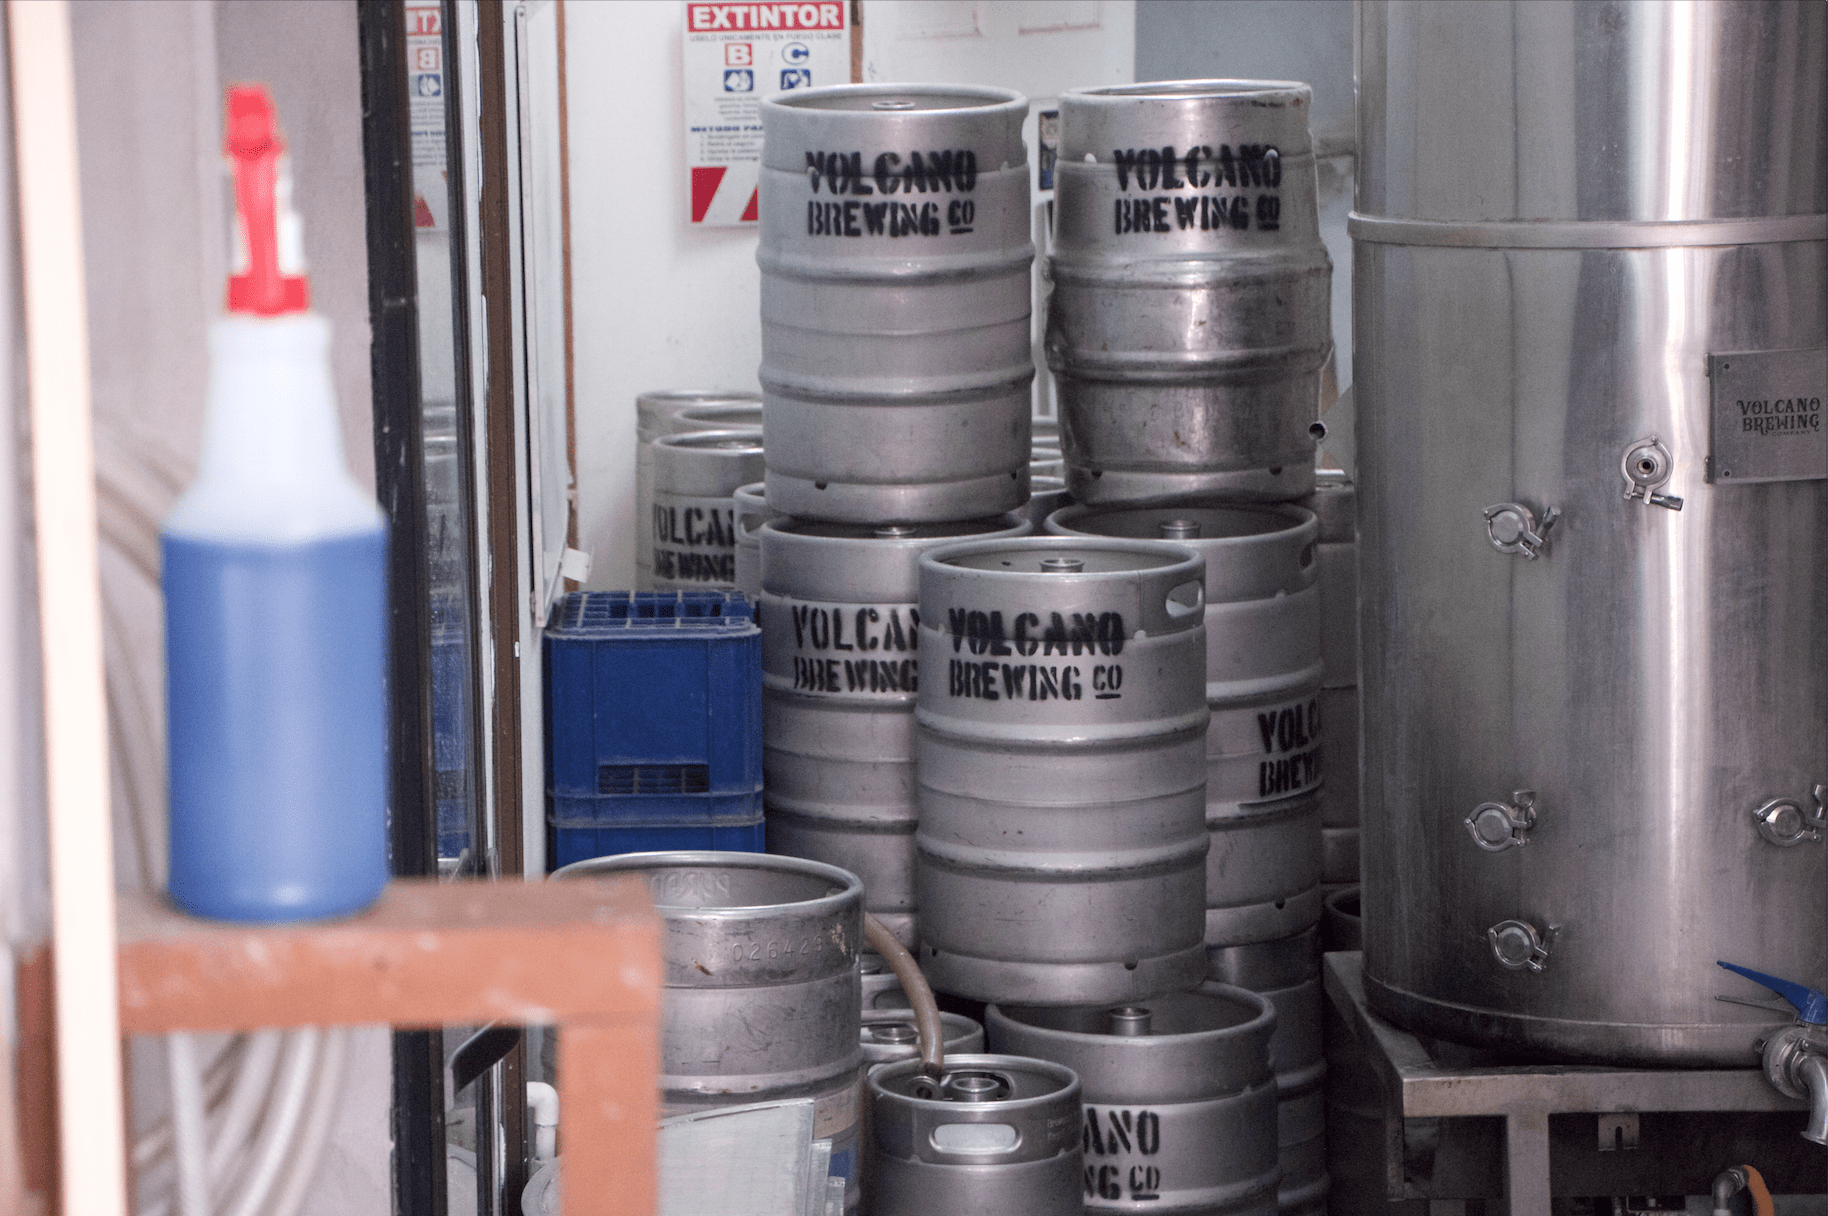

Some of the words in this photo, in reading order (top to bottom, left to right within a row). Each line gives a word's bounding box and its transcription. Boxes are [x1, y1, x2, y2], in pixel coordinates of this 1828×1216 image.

[692, 4, 840, 29] EXTINTOR
[727, 45, 750, 65] B
[805, 150, 976, 195] VOLCANO
[1113, 143, 1281, 191] VOLCANO
[807, 200, 940, 237] BREWING
[948, 199, 975, 235] CO
[1115, 196, 1249, 234] BREWING
[1737, 397, 1820, 416] VOLCANO
[1742, 414, 1820, 435] BREWING
[1771, 429, 1811, 437] COMPANY
[948, 607, 1124, 657] VOLCANO
[794, 656, 918, 693] BREWING
[950, 659, 1082, 701] BREWING
[1093, 665, 1122, 699] CO
[732, 934, 823, 963] 026429
[1129, 1165, 1160, 1200] CO
